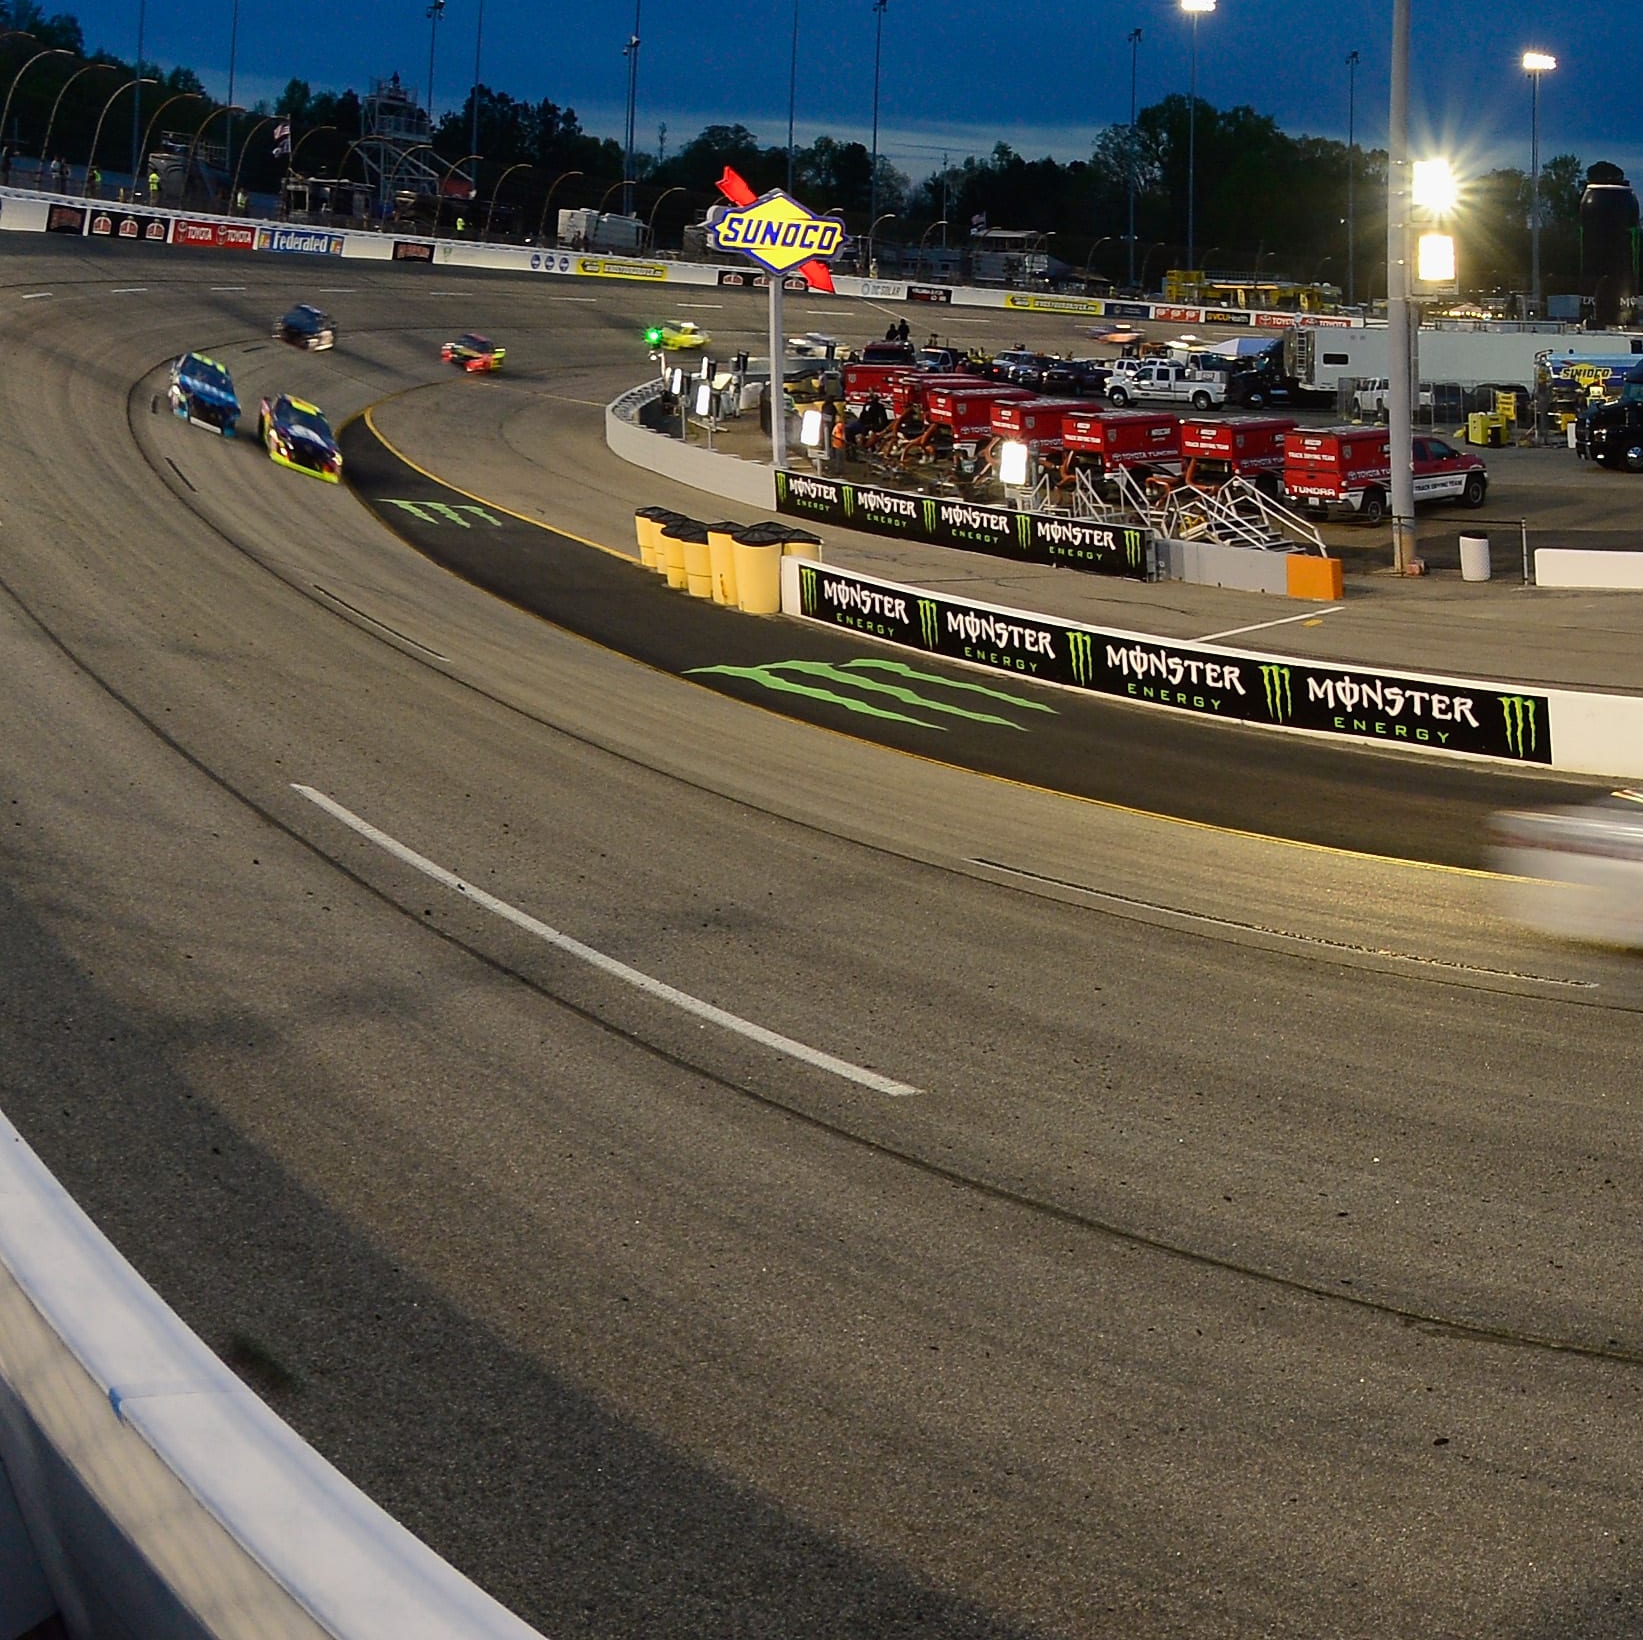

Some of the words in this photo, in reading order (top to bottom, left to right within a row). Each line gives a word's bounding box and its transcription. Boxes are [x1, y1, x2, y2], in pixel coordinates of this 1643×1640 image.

[188, 227, 212, 241] TOYOTA
[227, 229, 252, 243] TOYOTA
[272, 231, 328, 253] Federated
[722, 217, 838, 250] SUNOCO
[788, 477, 838, 503] MONSTER
[1291, 484, 1336, 497] TUNDRA
[796, 498, 830, 512] ENERGY
[857, 490, 917, 519] MONSTER
[866, 513, 908, 528] ENERGY
[940, 504, 1011, 534] MONSTER
[951, 528, 1000, 545] ENERGY
[1037, 520, 1116, 551] MONSTER
[1049, 545, 1104, 561] ENERGY
[823, 579, 909, 625] MONSTER
[836, 612, 895, 638] ENERGY
[946, 610, 1056, 659] MONSTER
[964, 646, 1039, 673] ENERGY
[1105, 643, 1247, 695] MONSTER
[1127, 682, 1223, 711] ENERGY
[1306, 674, 1479, 728] MONSTER
[1333, 716, 1450, 745] ENERGY
